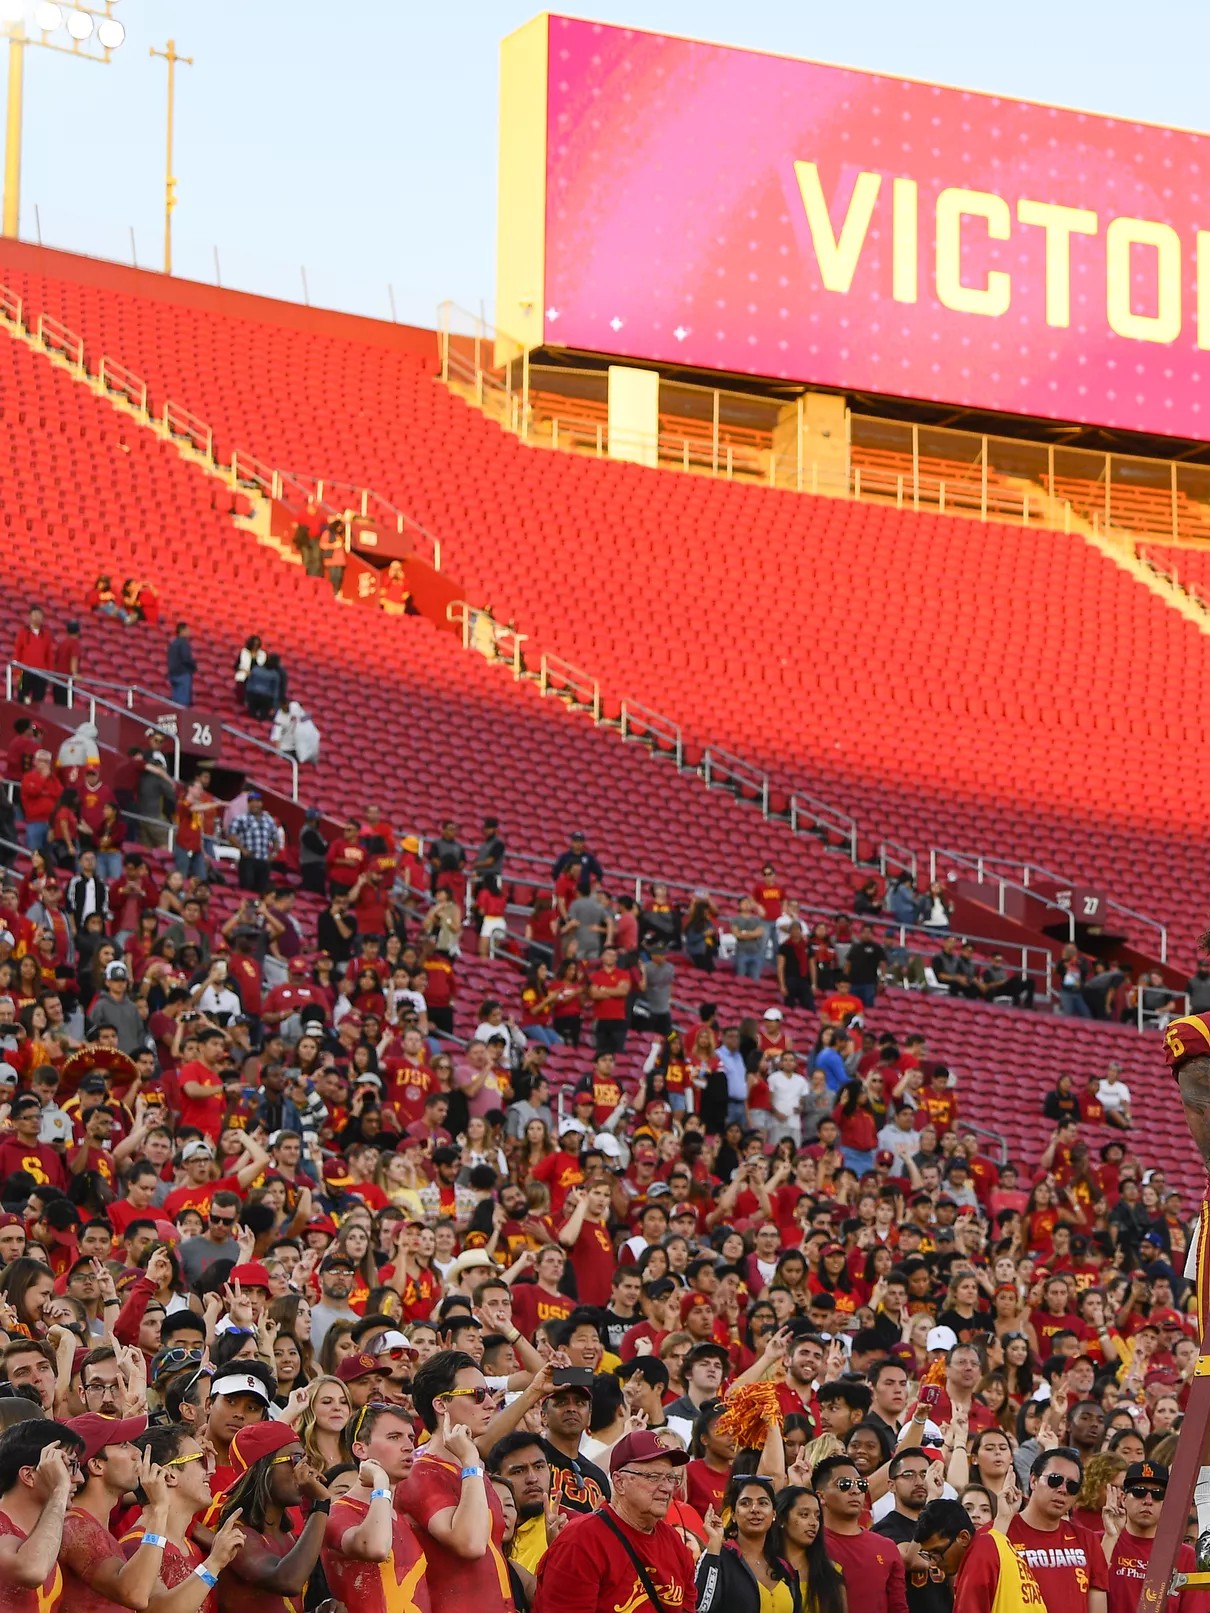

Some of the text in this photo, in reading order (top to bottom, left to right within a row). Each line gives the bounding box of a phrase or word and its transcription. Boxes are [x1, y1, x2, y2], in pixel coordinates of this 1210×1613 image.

[191, 722, 212, 746] 26
[1083, 897, 1099, 915] 27
[1166, 1028, 1185, 1058] 6
[608, 1325, 623, 1333] NO
[1017, 1548, 1087, 1568] TROJANS
[1117, 1556, 1136, 1568] USC
[1075, 1568, 1088, 1593] SC
[1116, 1567, 1127, 1576] of
